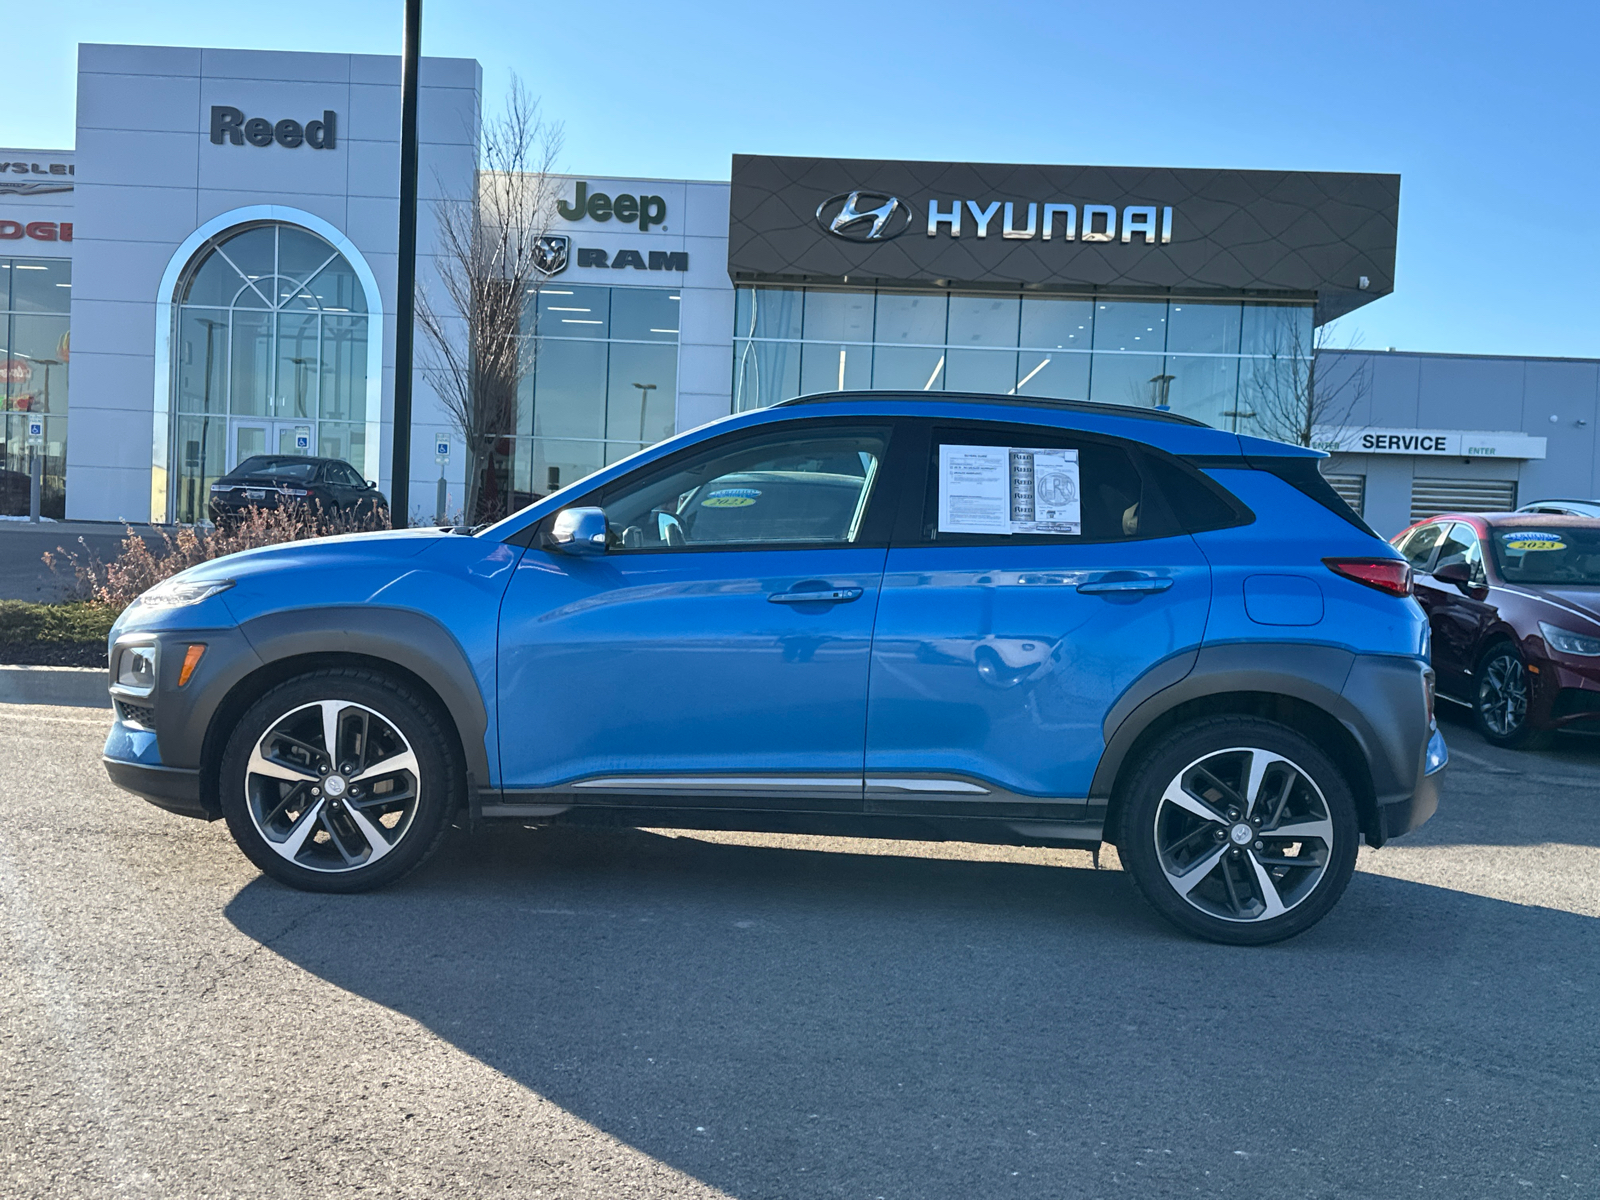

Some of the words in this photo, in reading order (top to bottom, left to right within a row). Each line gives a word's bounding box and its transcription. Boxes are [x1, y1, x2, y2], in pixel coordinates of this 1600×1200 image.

[210, 104, 337, 149] Reed
[557, 181, 667, 231] Jeep
[927, 199, 1173, 243] HYUNDAI
[577, 248, 689, 271] RAM
[1362, 434, 1447, 451] SERVICE
[1468, 446, 1496, 455] ENTER
[1517, 541, 1556, 549] 2023
